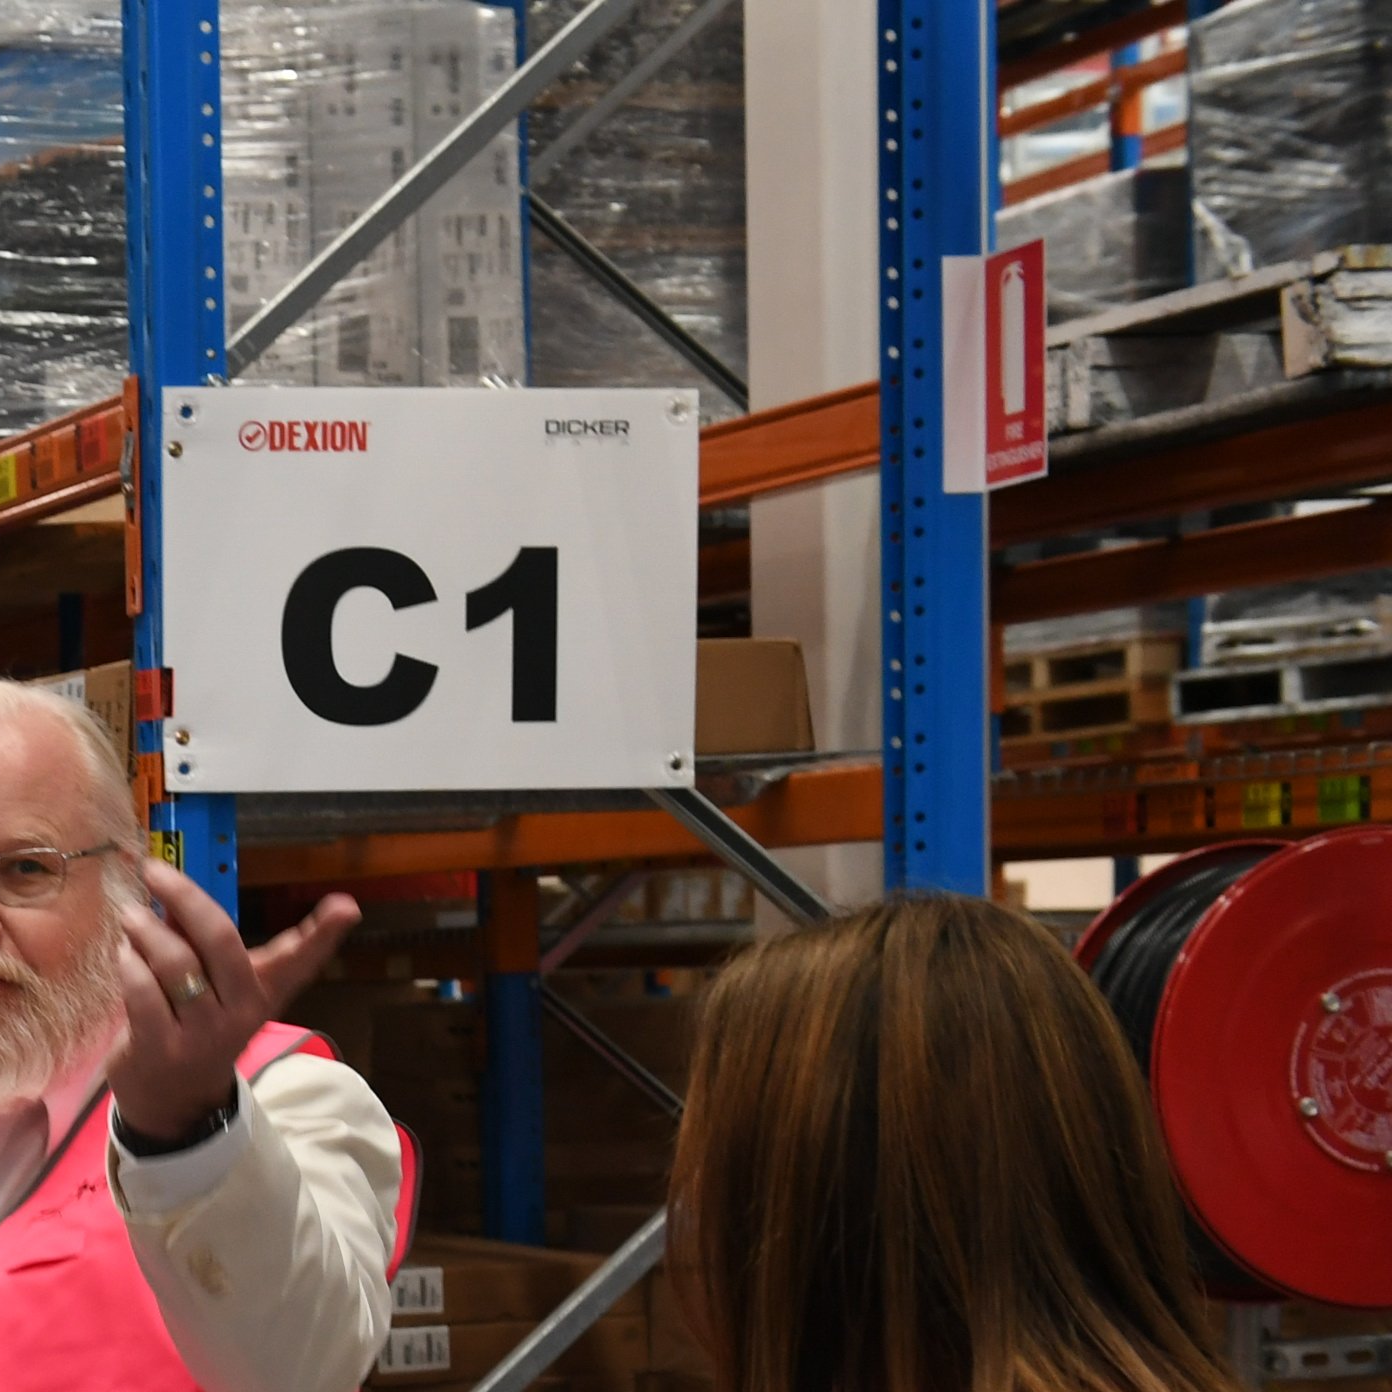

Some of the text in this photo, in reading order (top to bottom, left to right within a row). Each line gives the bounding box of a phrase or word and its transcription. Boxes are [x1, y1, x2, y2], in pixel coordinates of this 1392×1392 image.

[268, 420, 368, 452] DEXION
[545, 419, 630, 437] DICKER
[281, 545, 558, 726] C1
